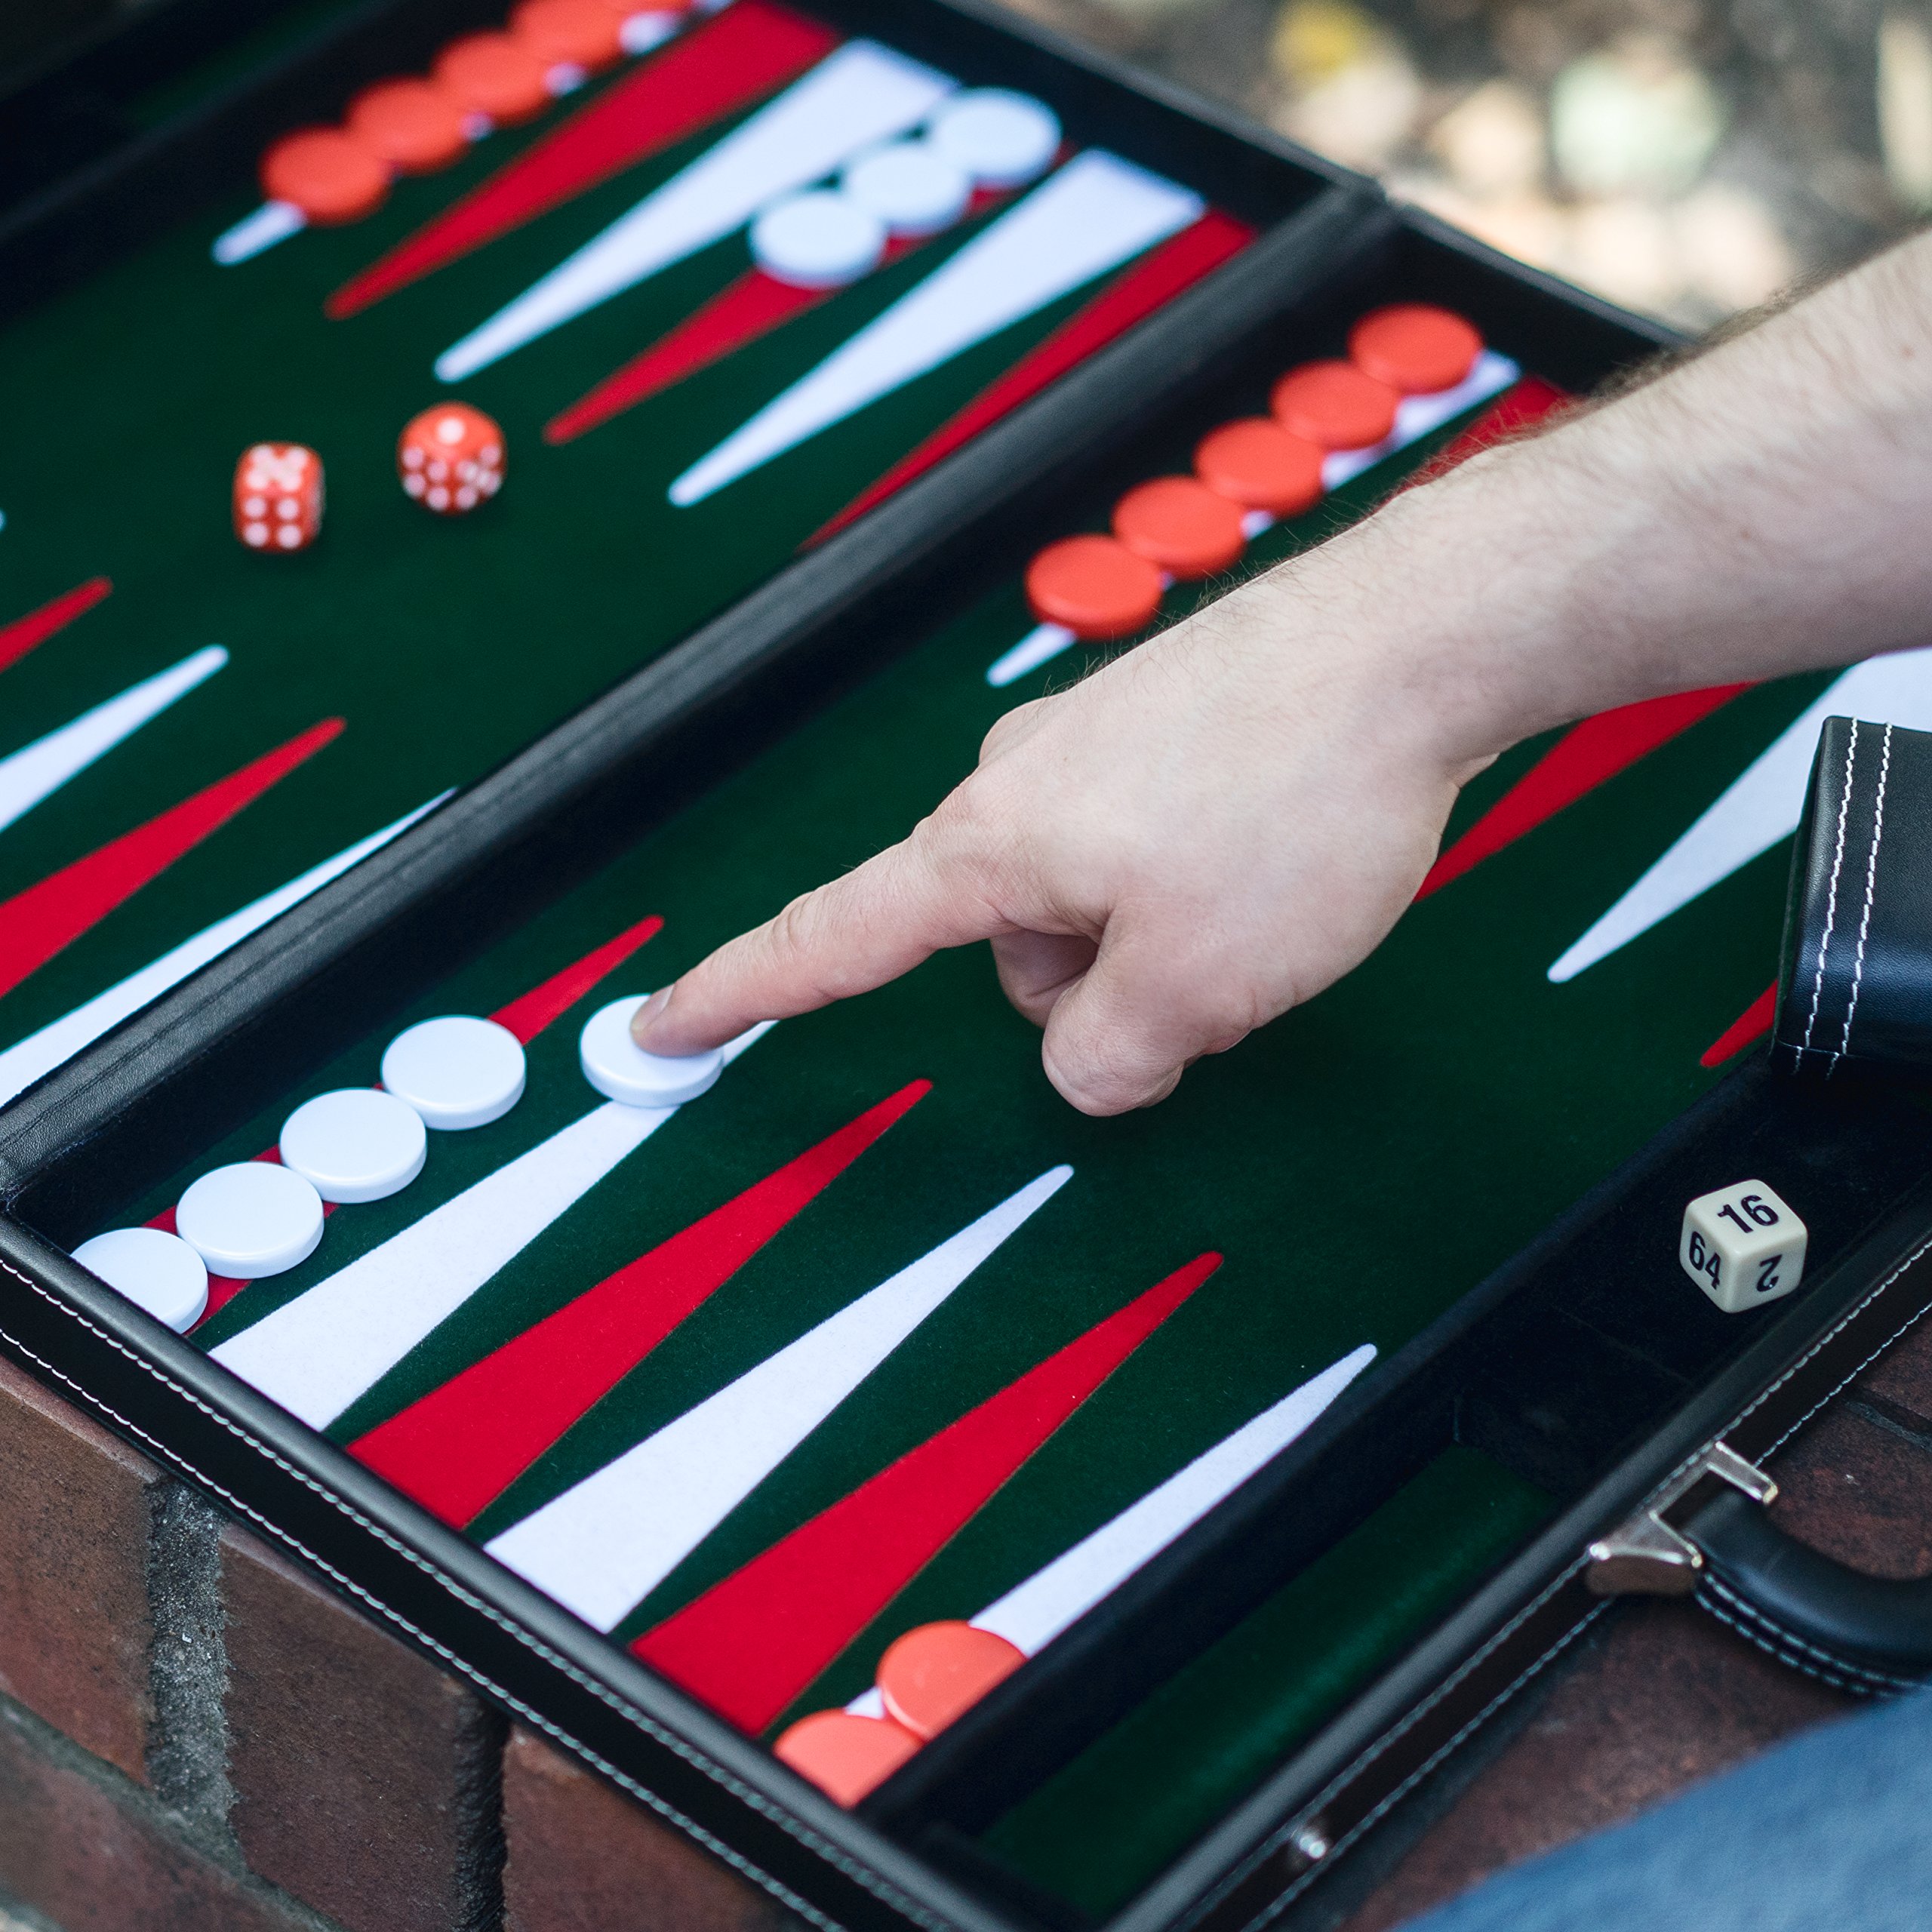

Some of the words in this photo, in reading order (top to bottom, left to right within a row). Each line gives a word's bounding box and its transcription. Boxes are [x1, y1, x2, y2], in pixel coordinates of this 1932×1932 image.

[1717, 1195, 1779, 1233] 16
[1689, 1231, 1721, 1290] 64
[1756, 1254, 1783, 1293] 2
